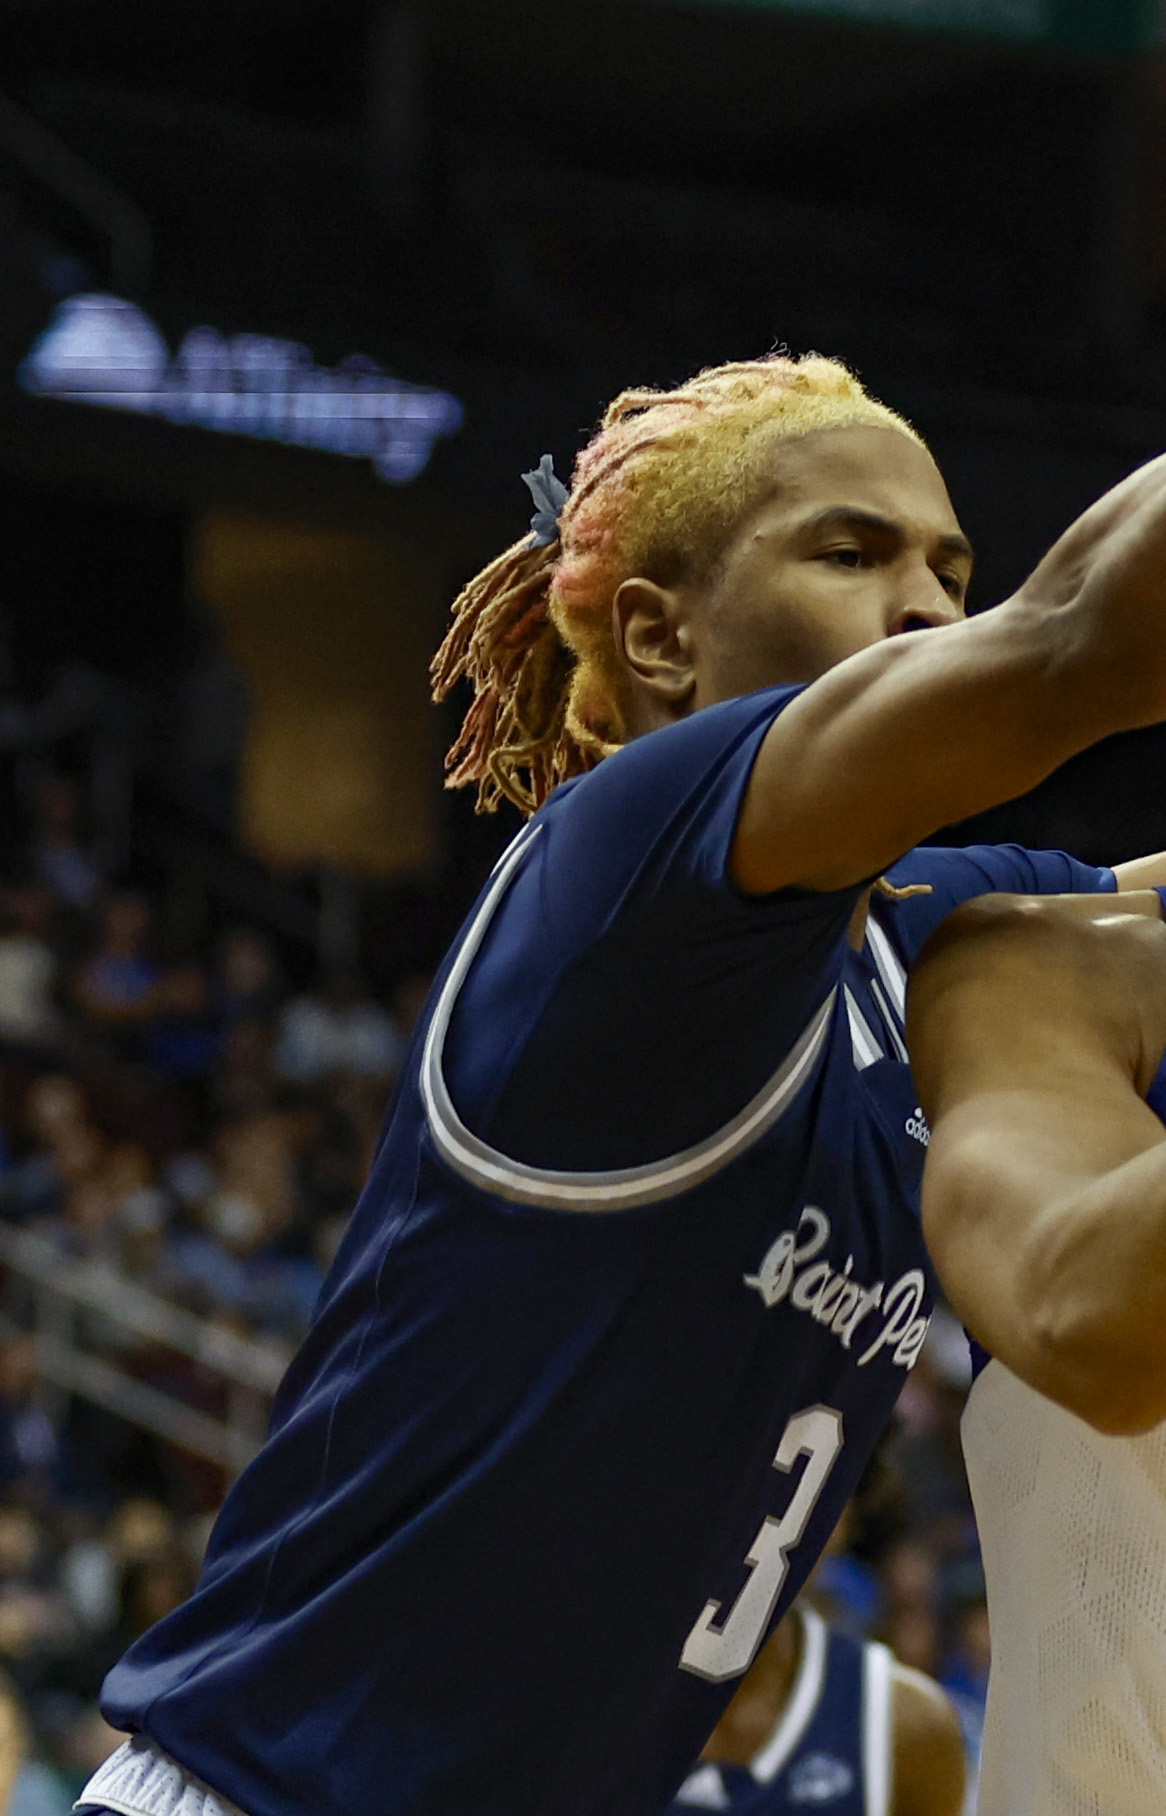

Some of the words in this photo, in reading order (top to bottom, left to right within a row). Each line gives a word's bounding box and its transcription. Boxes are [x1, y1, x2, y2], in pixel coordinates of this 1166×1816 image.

[743, 1204, 885, 1350] Saint
[857, 1268, 935, 1372] Pe
[677, 1402, 846, 1685] 3
